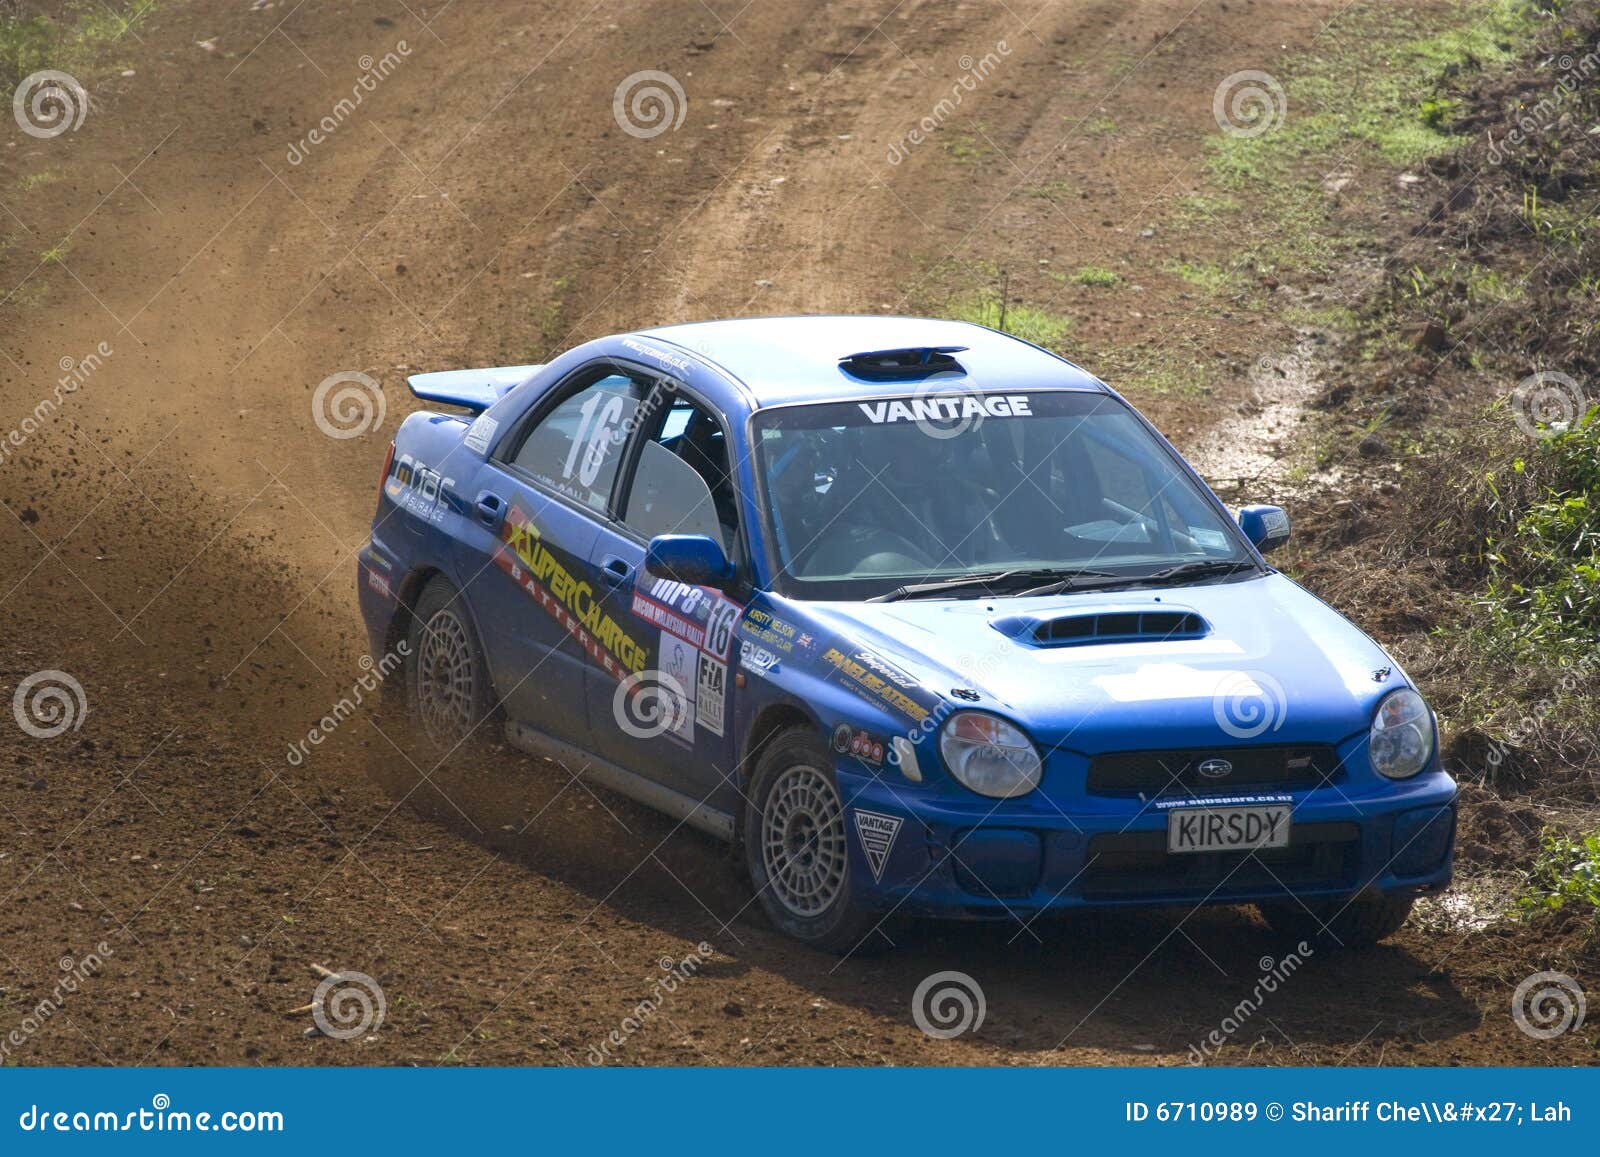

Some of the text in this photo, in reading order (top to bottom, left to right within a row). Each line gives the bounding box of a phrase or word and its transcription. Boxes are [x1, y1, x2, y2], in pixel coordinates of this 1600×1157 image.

[858, 395, 1033, 424] VANTAGE
[562, 392, 624, 488] 16
[709, 605, 736, 656] 16
[740, 640, 781, 669] EXEDY
[700, 658, 723, 696] FIA
[859, 815, 896, 831] VANTAGE
[1179, 811, 1282, 847] KIRSDY
